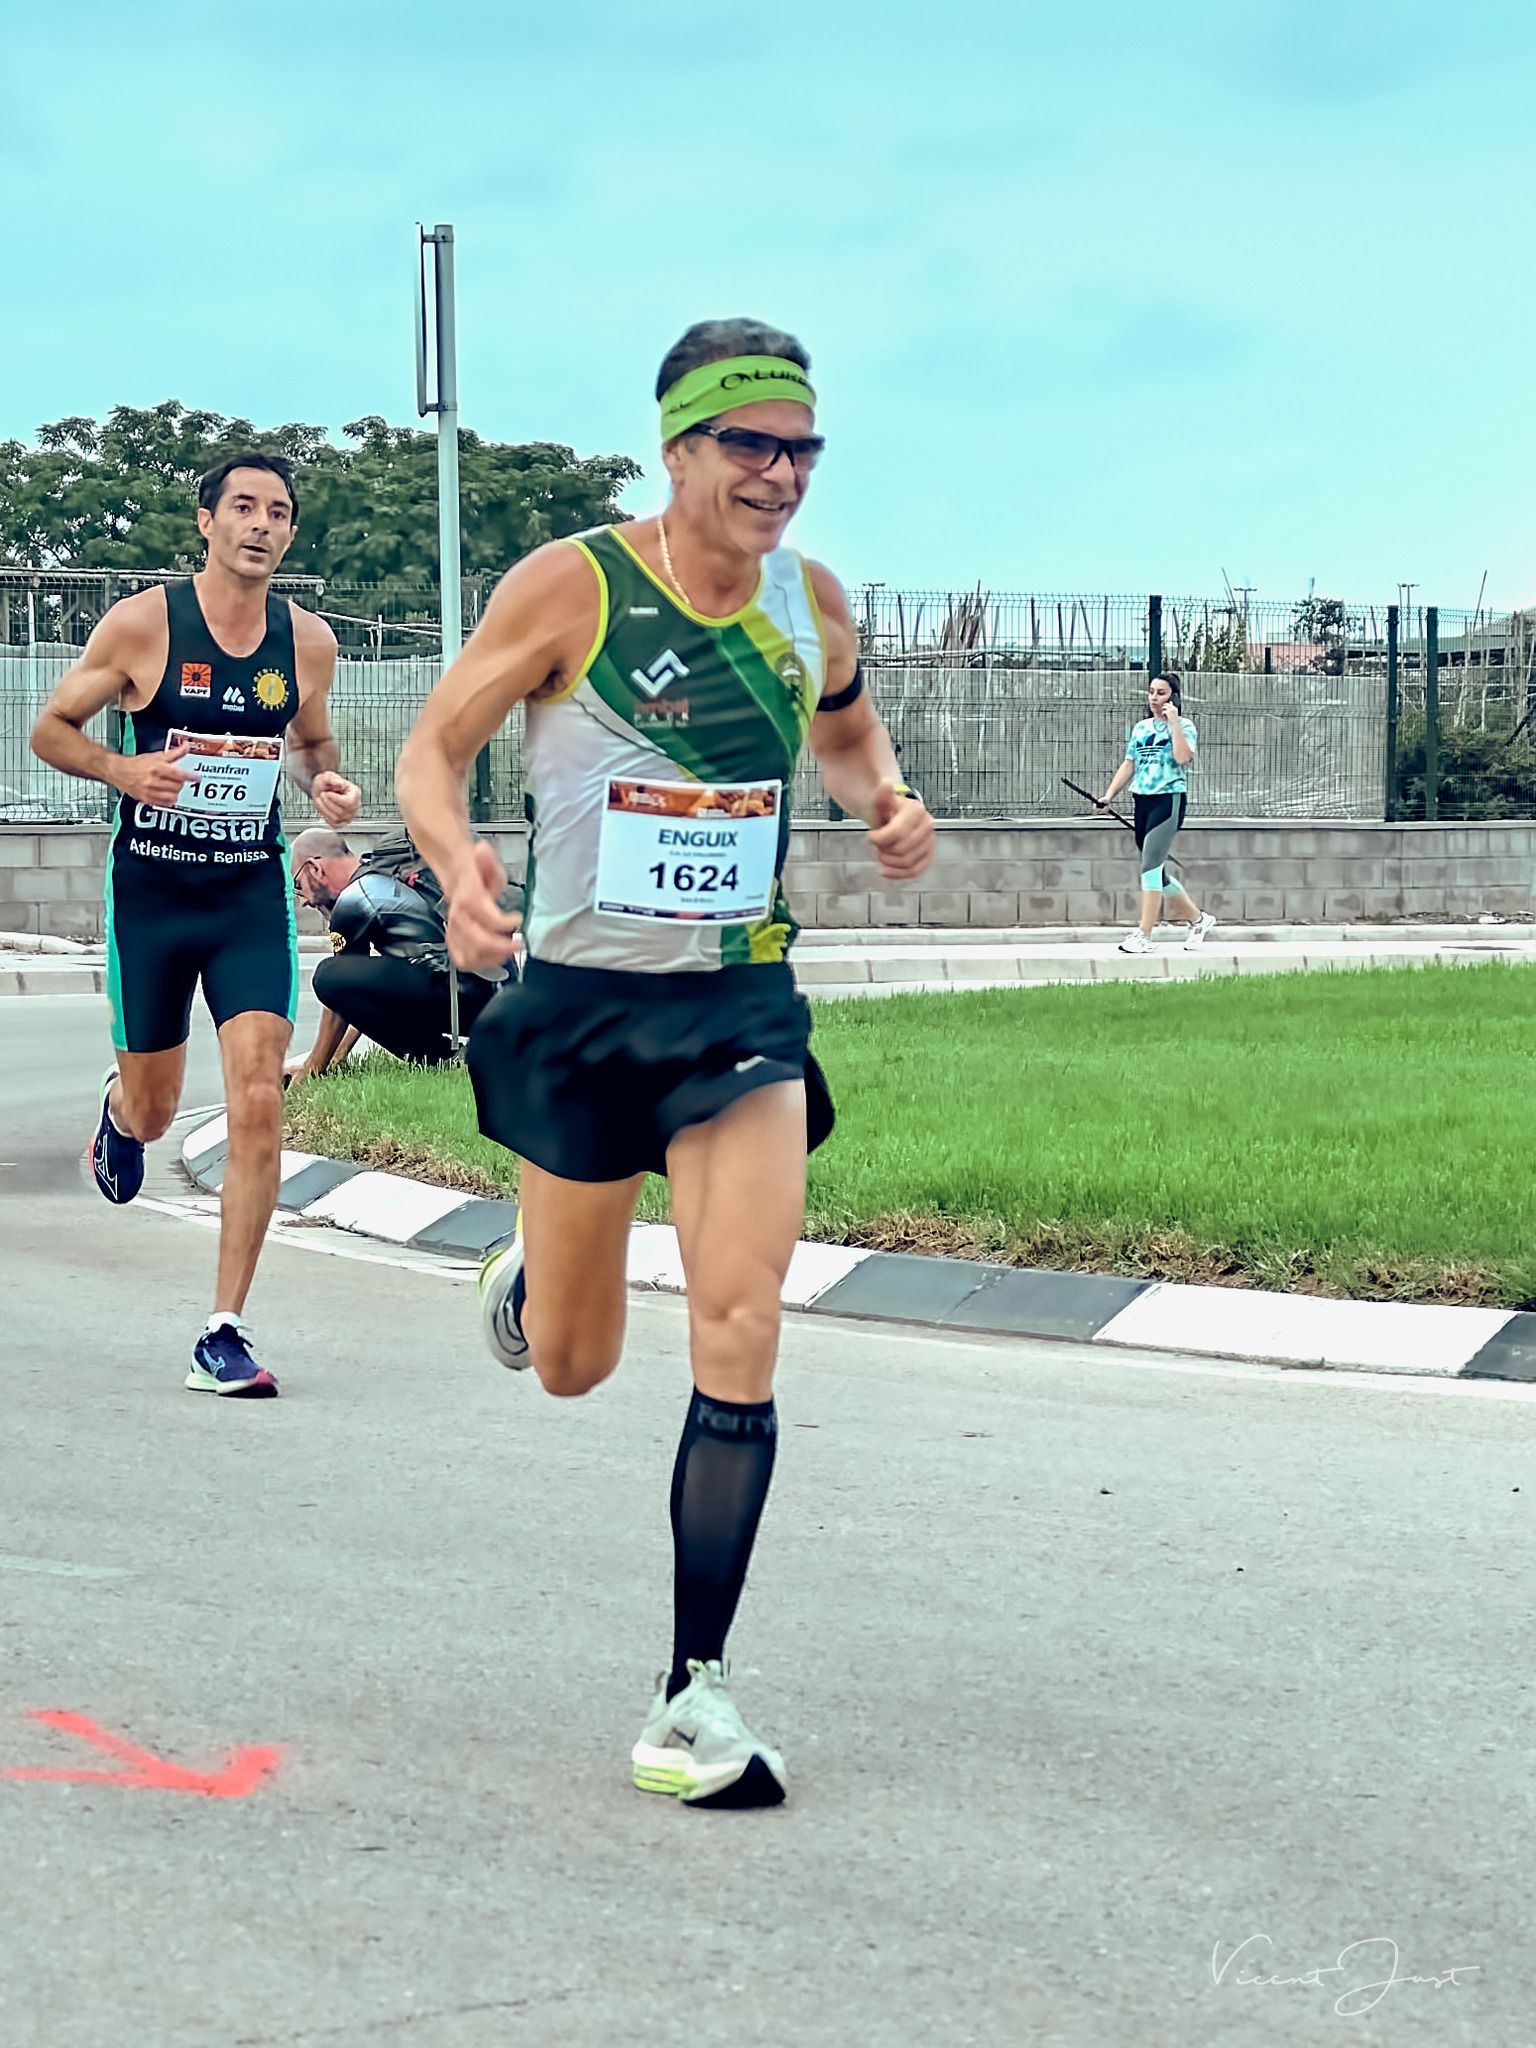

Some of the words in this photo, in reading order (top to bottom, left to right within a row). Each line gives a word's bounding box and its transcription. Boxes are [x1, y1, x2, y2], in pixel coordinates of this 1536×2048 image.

[184, 687, 208, 695] VAPF
[194, 762, 250, 776] Juanfran
[190, 781, 248, 802] 1676
[134, 801, 270, 842] Ginestar
[658, 828, 738, 848] ENGUIX
[213, 849, 270, 864] Benissa
[649, 861, 739, 892] 1624
